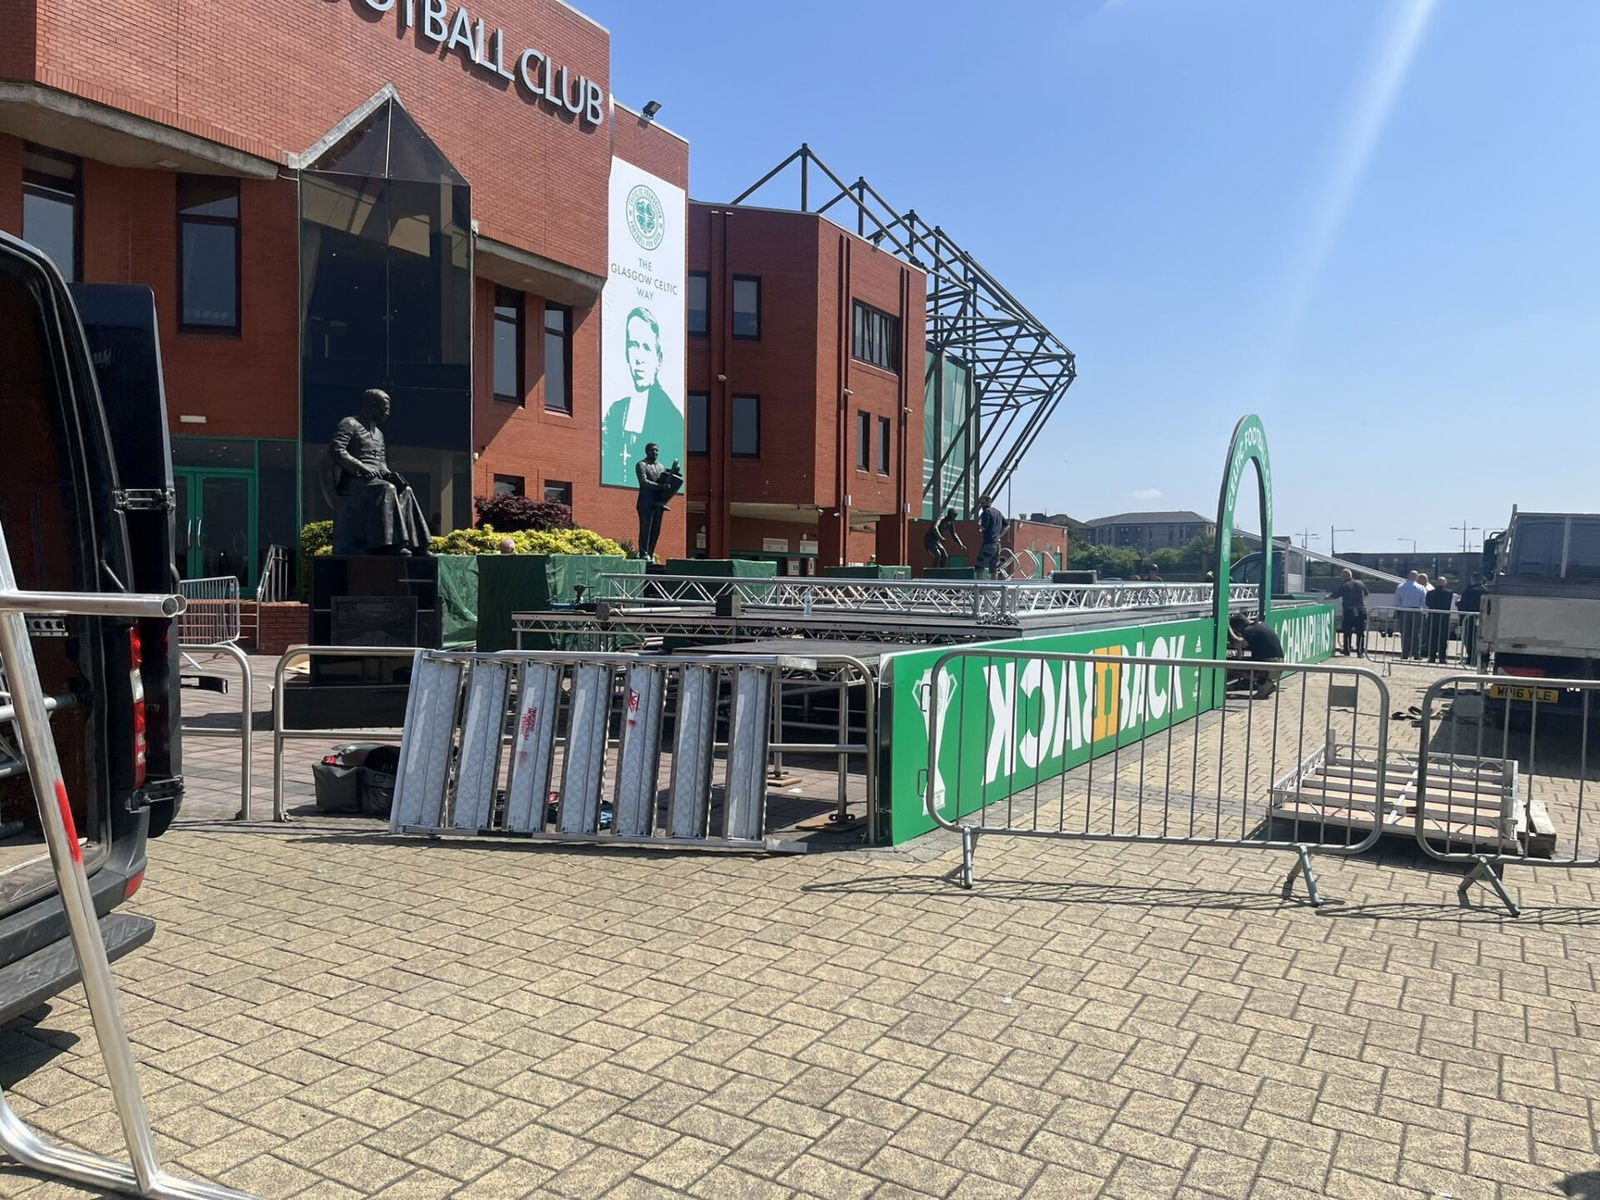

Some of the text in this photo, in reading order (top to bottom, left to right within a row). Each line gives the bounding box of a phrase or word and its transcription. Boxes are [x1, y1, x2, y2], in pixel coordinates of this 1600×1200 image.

[365, 0, 605, 126] BALL CLUB
[610, 262, 678, 296] GLASGOW CELTIC
[638, 257, 652, 272] THE
[636, 287, 654, 302] WAY
[1227, 440, 1245, 512] CELTIC
[1120, 635, 1186, 733] BACK
